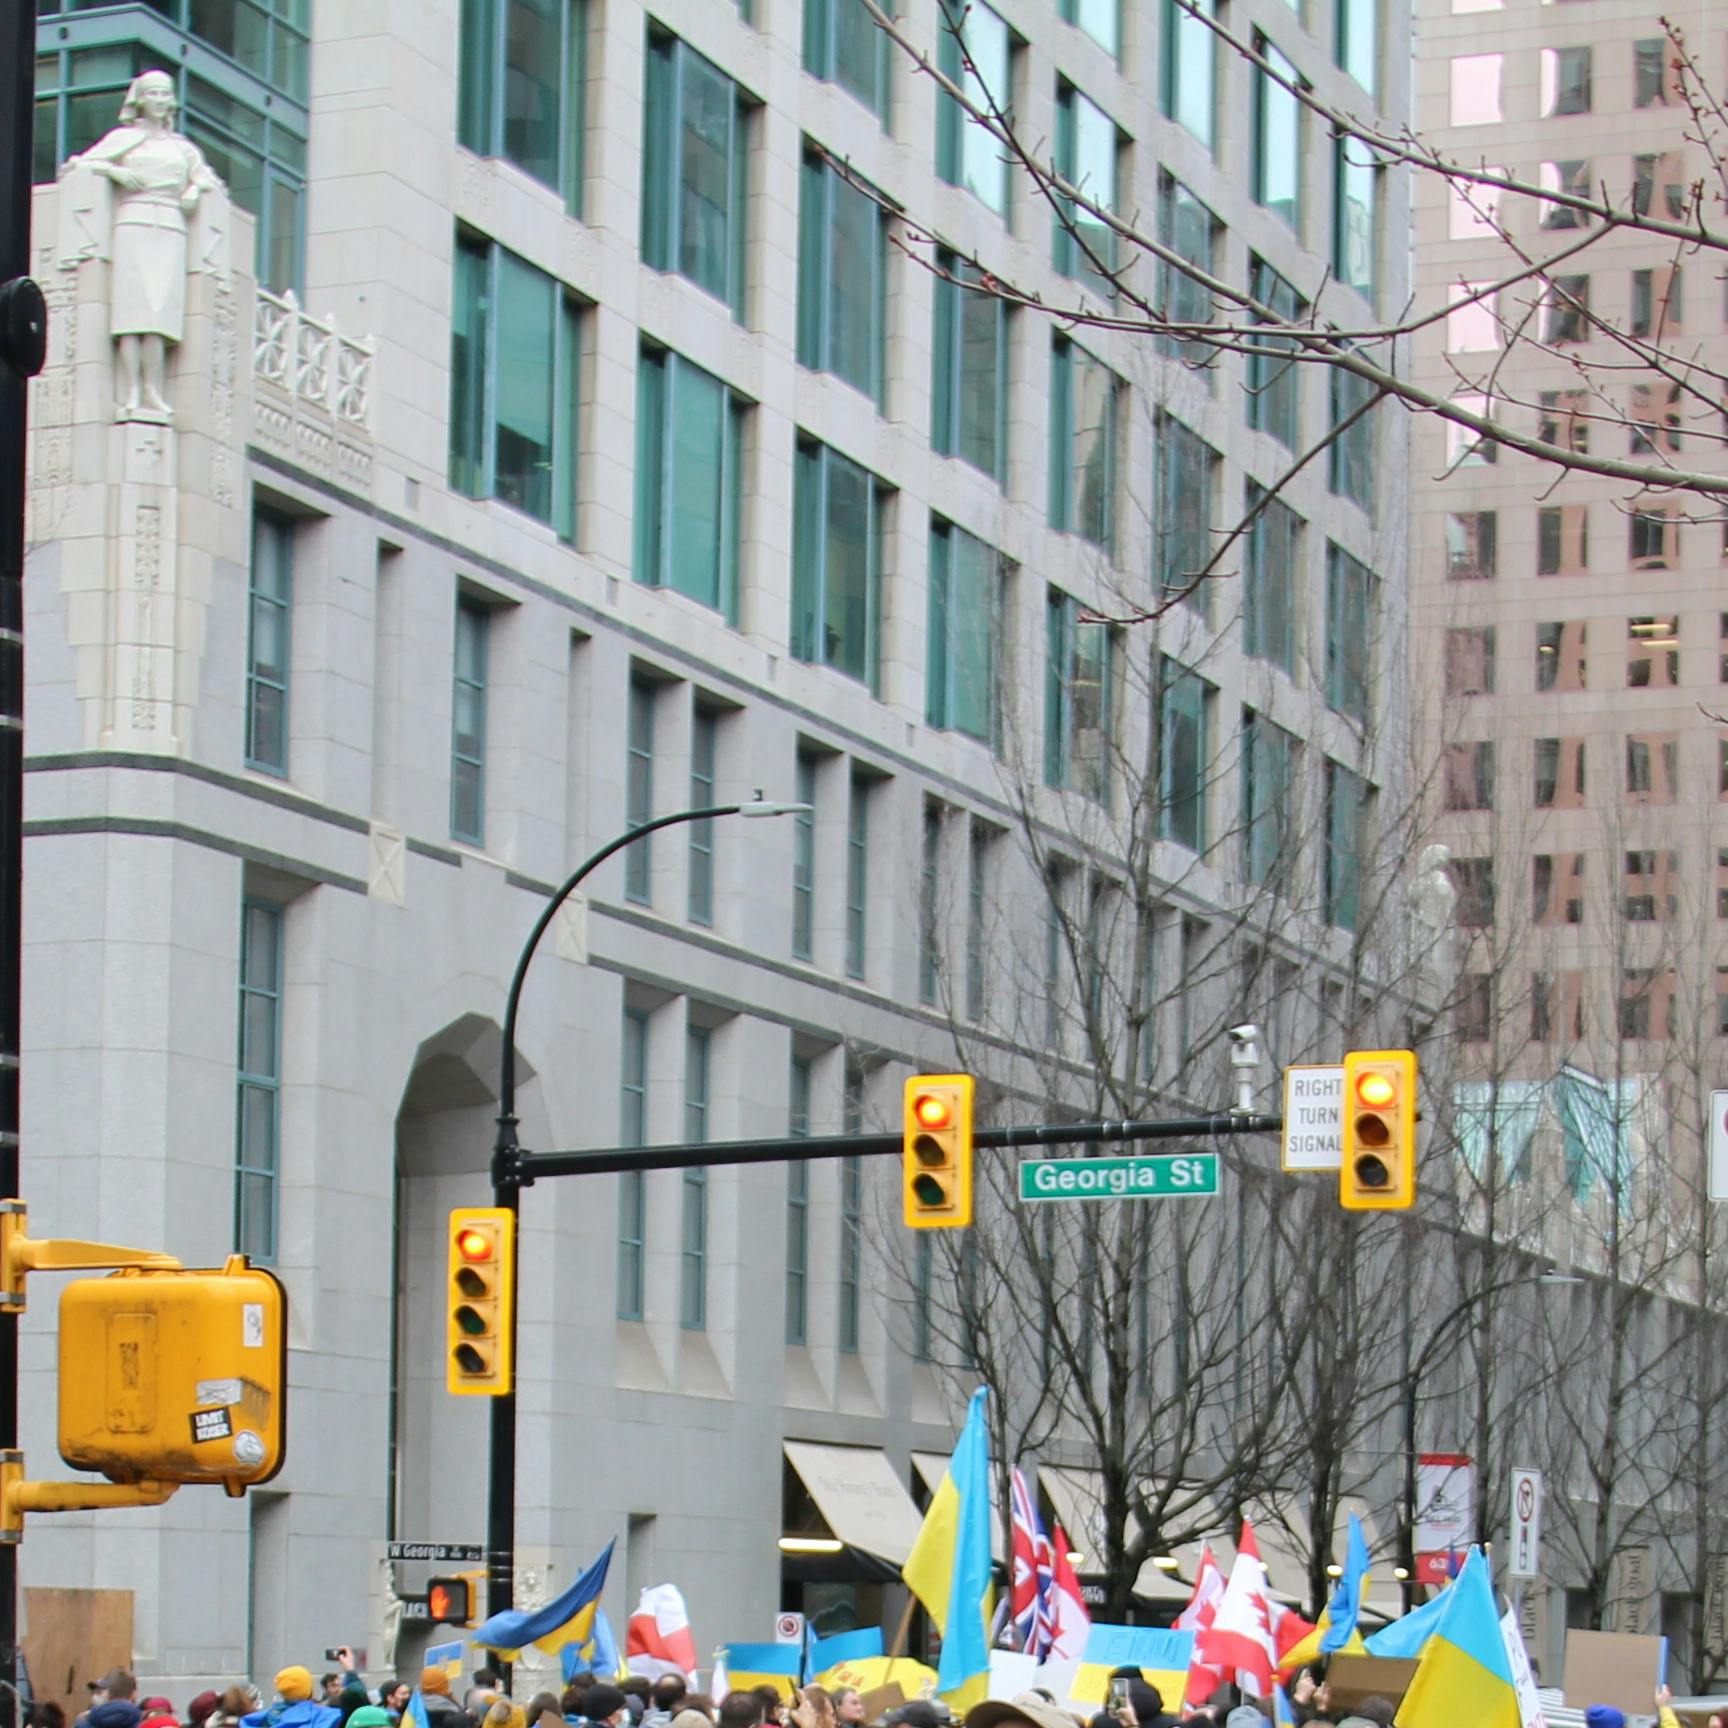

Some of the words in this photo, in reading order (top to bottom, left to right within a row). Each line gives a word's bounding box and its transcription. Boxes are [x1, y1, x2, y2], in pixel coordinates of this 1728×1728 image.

[1295, 1078, 1342, 1097] RIGHT
[1298, 1107, 1339, 1124] TURN
[1288, 1134, 1343, 1152] SIGNAL
[1034, 1161, 1156, 1194] Georgia
[1170, 1159, 1204, 1186] St
[391, 1543, 401, 1557] W
[403, 1543, 446, 1560] Georgia
